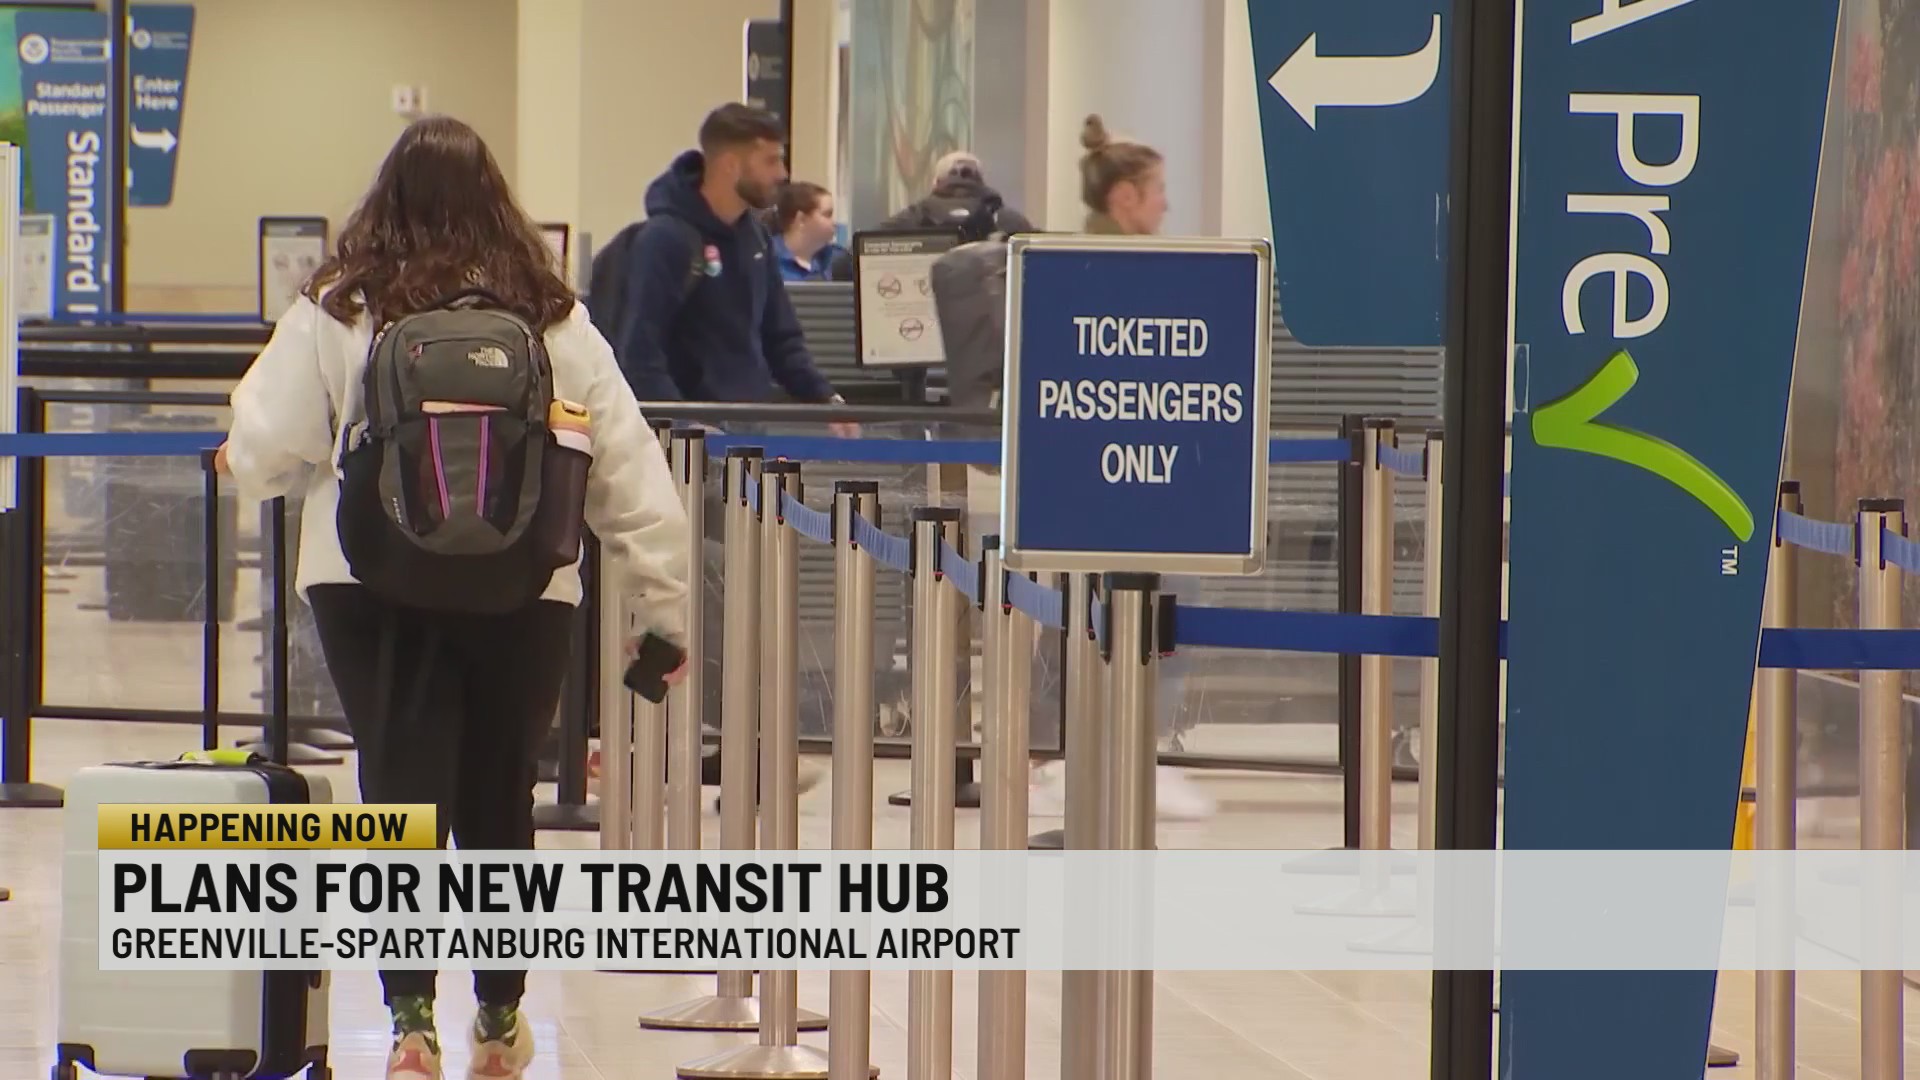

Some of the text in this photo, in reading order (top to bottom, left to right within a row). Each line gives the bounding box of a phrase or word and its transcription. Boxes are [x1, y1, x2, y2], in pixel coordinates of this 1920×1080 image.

[36, 81, 106, 99] Standard
[134, 75, 181, 93] Enter
[135, 94, 178, 110] Here
[27, 99, 105, 119] Passenger
[66, 131, 100, 293] Standard
[1562, 92, 1700, 338] Pre
[1073, 316, 1209, 357] TICKETED
[1039, 379, 1243, 423] PASSENGERS
[1101, 443, 1179, 484] ONLY
